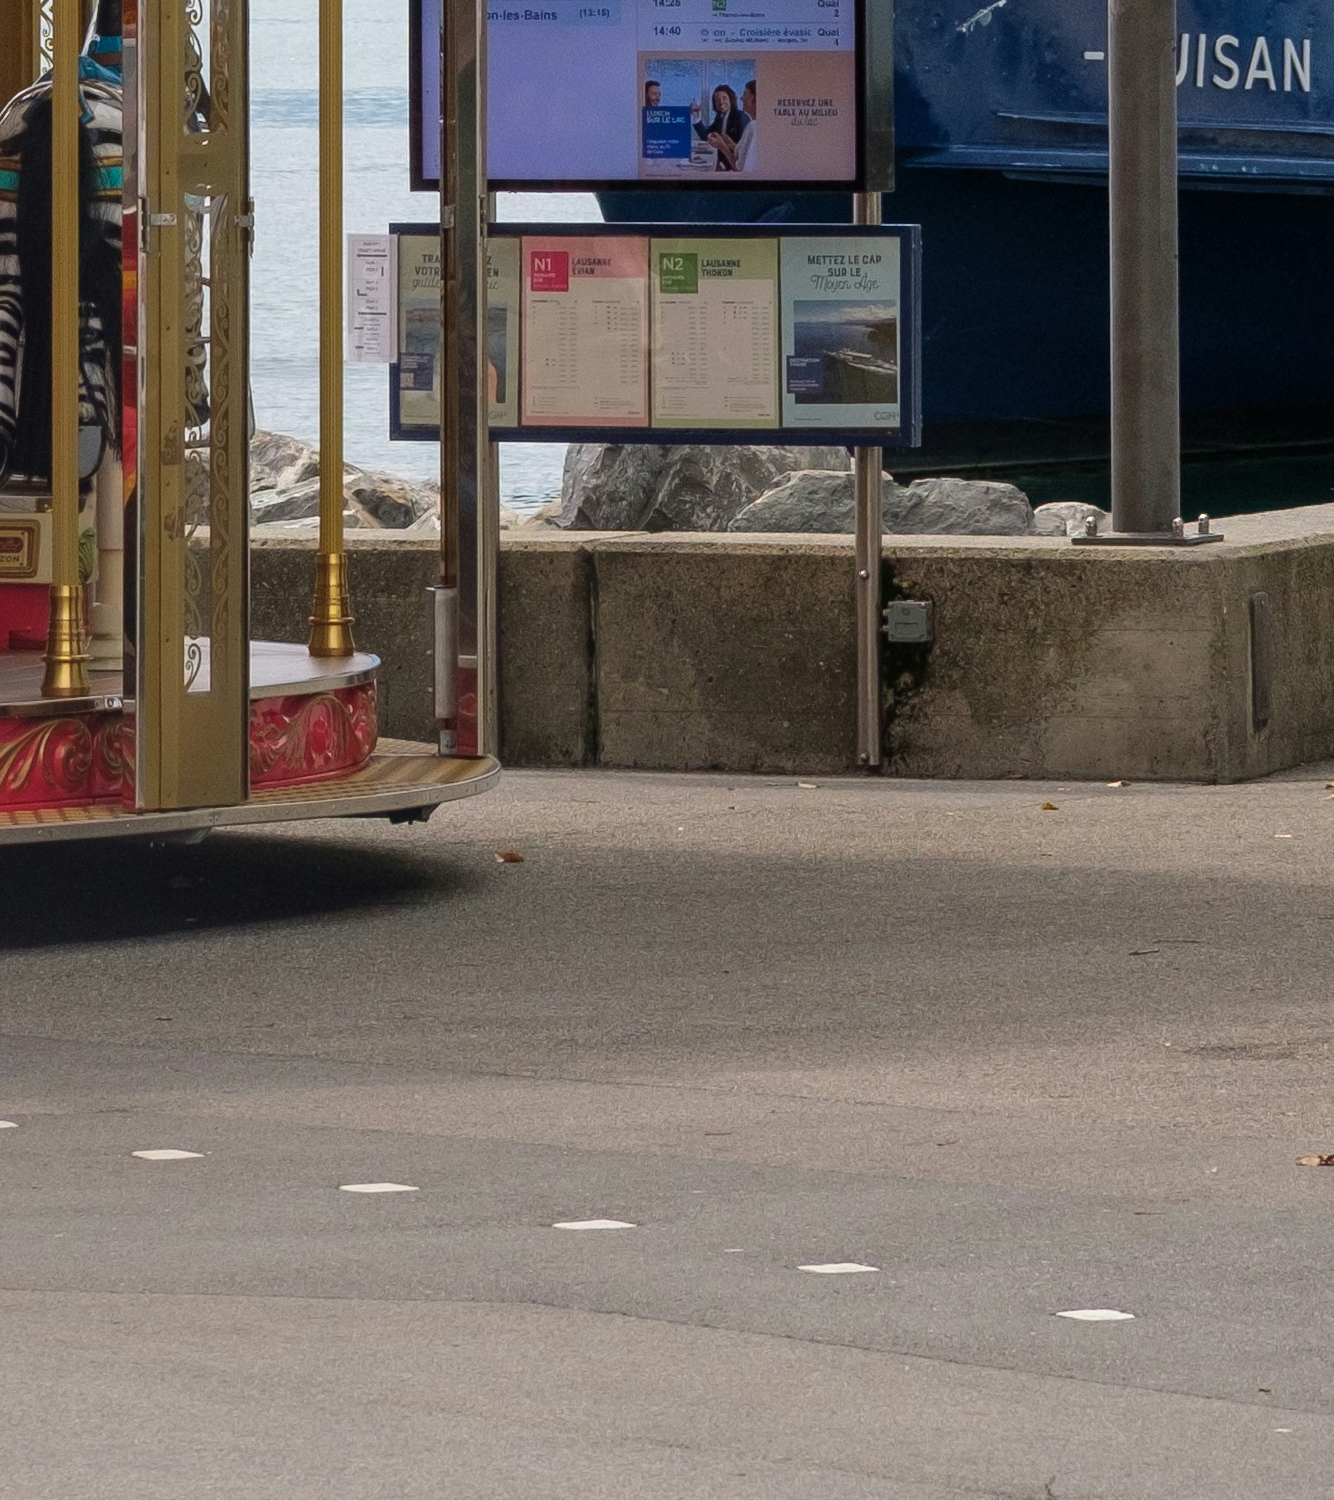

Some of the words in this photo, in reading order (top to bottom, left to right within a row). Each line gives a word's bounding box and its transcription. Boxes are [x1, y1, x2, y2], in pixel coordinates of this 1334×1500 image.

[817, 0, 839, 8] Quai
[834, 9, 839, 18] 2
[653, 26, 681, 36] 14:40
[817, 28, 839, 37] Quai
[1175, 32, 1312, 93] UISAN
[798, 108, 809, 116] AU
[534, 257, 552, 271] N1
[571, 257, 612, 266] LAUSANNE
[662, 257, 684, 271] N2
[701, 259, 741, 268] LAUSANNE
[807, 255, 844, 265] METTEZ
[848, 255, 860, 265] LE
[862, 255, 882, 265] CAP
[414, 266, 440, 277] VOTR
[827, 267, 848, 277] SUR
[850, 267, 861, 277] LE
